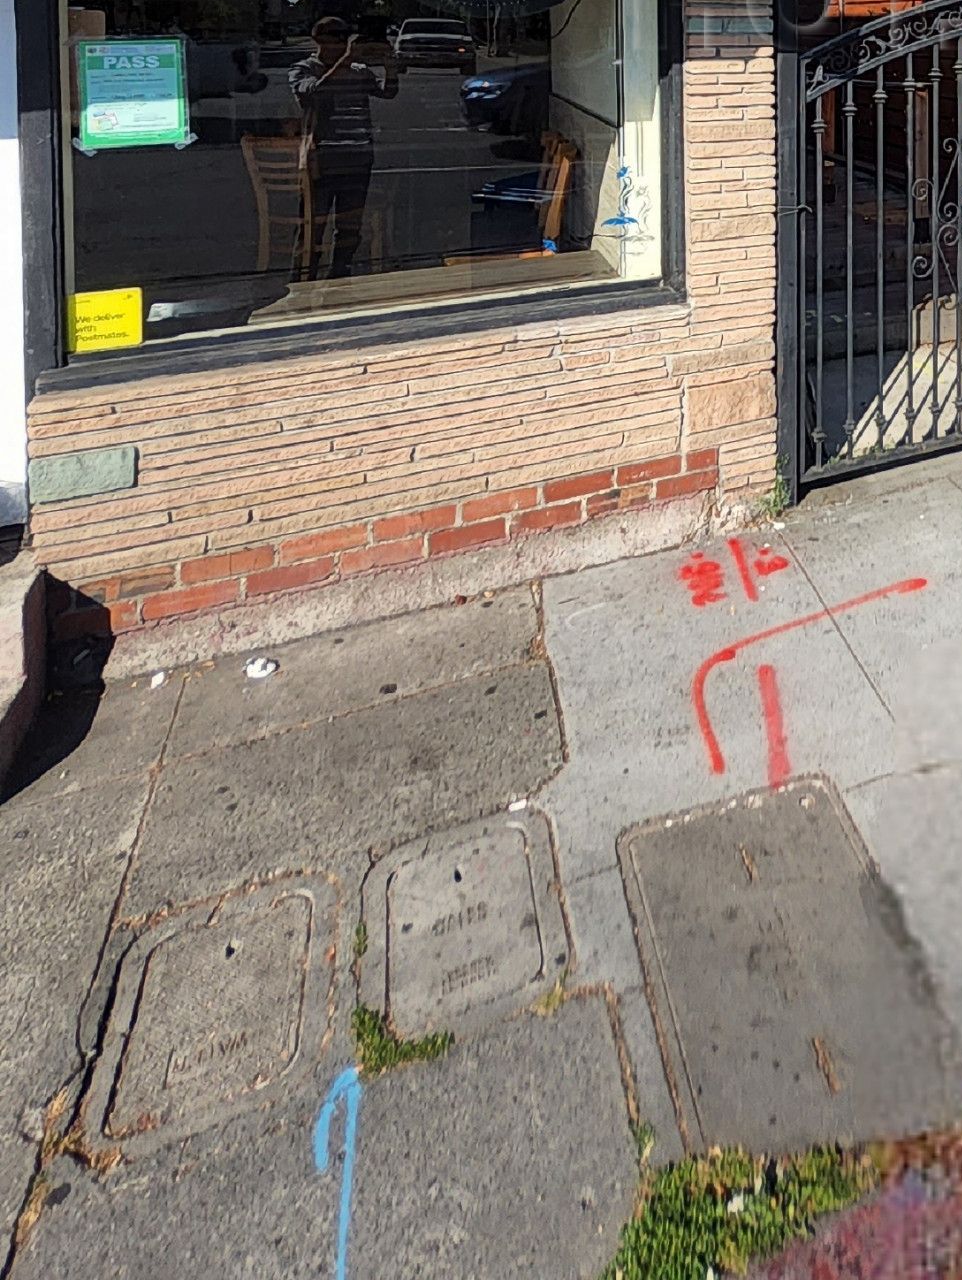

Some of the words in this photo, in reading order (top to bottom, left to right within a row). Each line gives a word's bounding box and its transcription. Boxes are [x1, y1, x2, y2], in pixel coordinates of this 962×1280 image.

[103, 55, 161, 70] PASS
[75, 316, 91, 324] We
[93, 312, 126, 322] deliver
[75, 325, 97, 334] with
